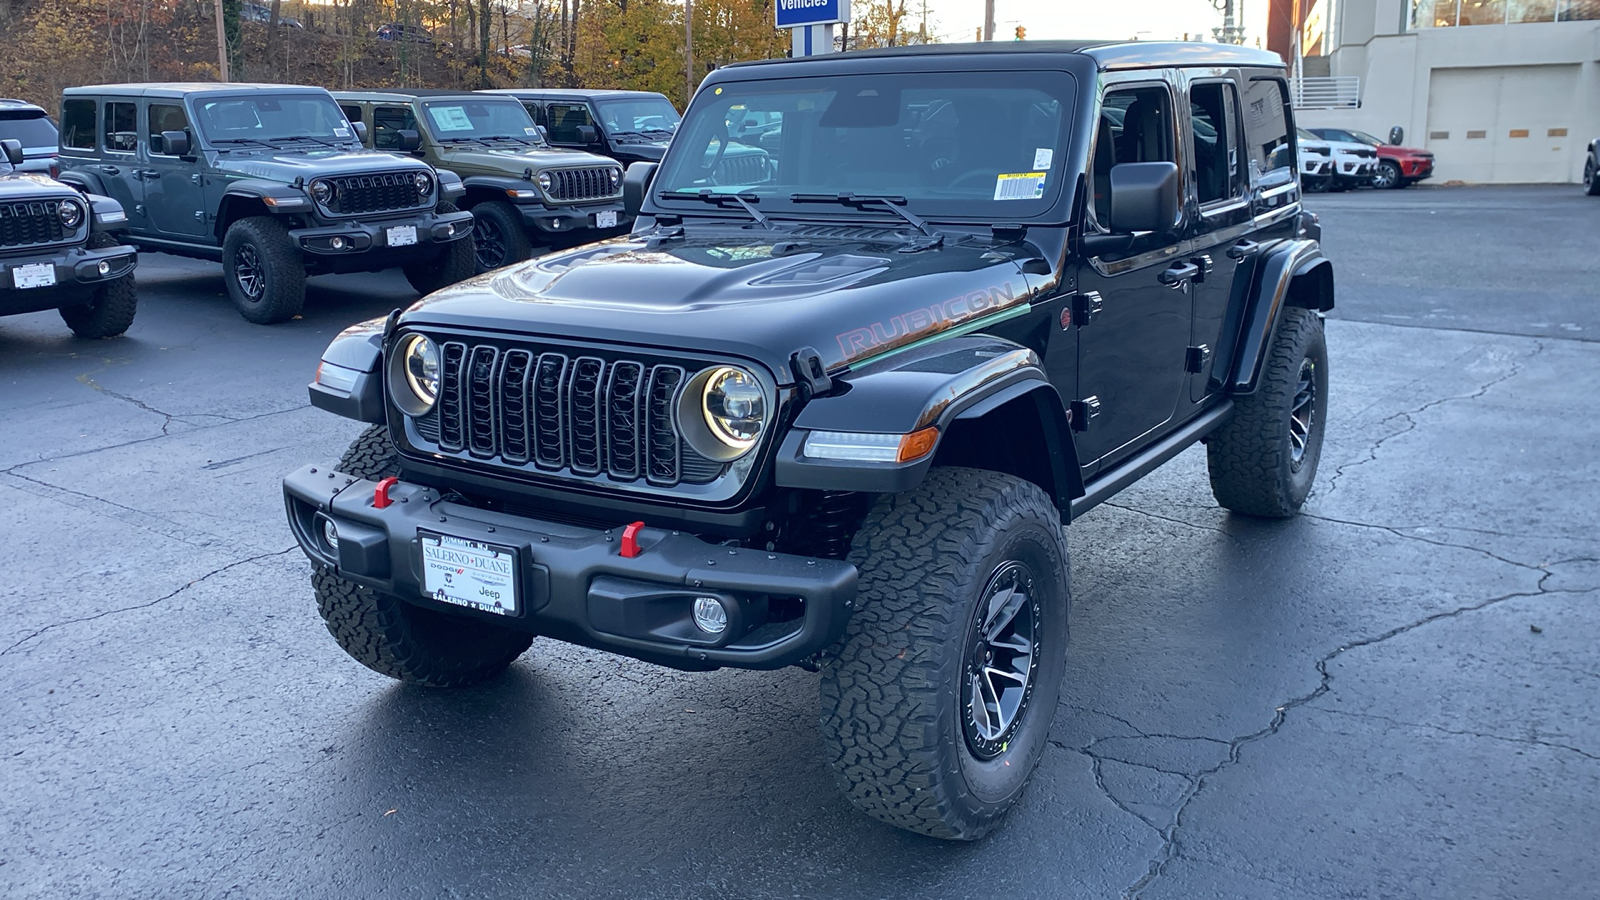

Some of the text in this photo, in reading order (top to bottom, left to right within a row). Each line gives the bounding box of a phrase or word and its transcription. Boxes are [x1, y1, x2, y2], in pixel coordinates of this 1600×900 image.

[836, 281, 1015, 358] RUBICON
[425, 547, 510, 574] SALERNO DUANE
[433, 593, 505, 615] SALERNO DUANE
[479, 586, 500, 599] Jeep
